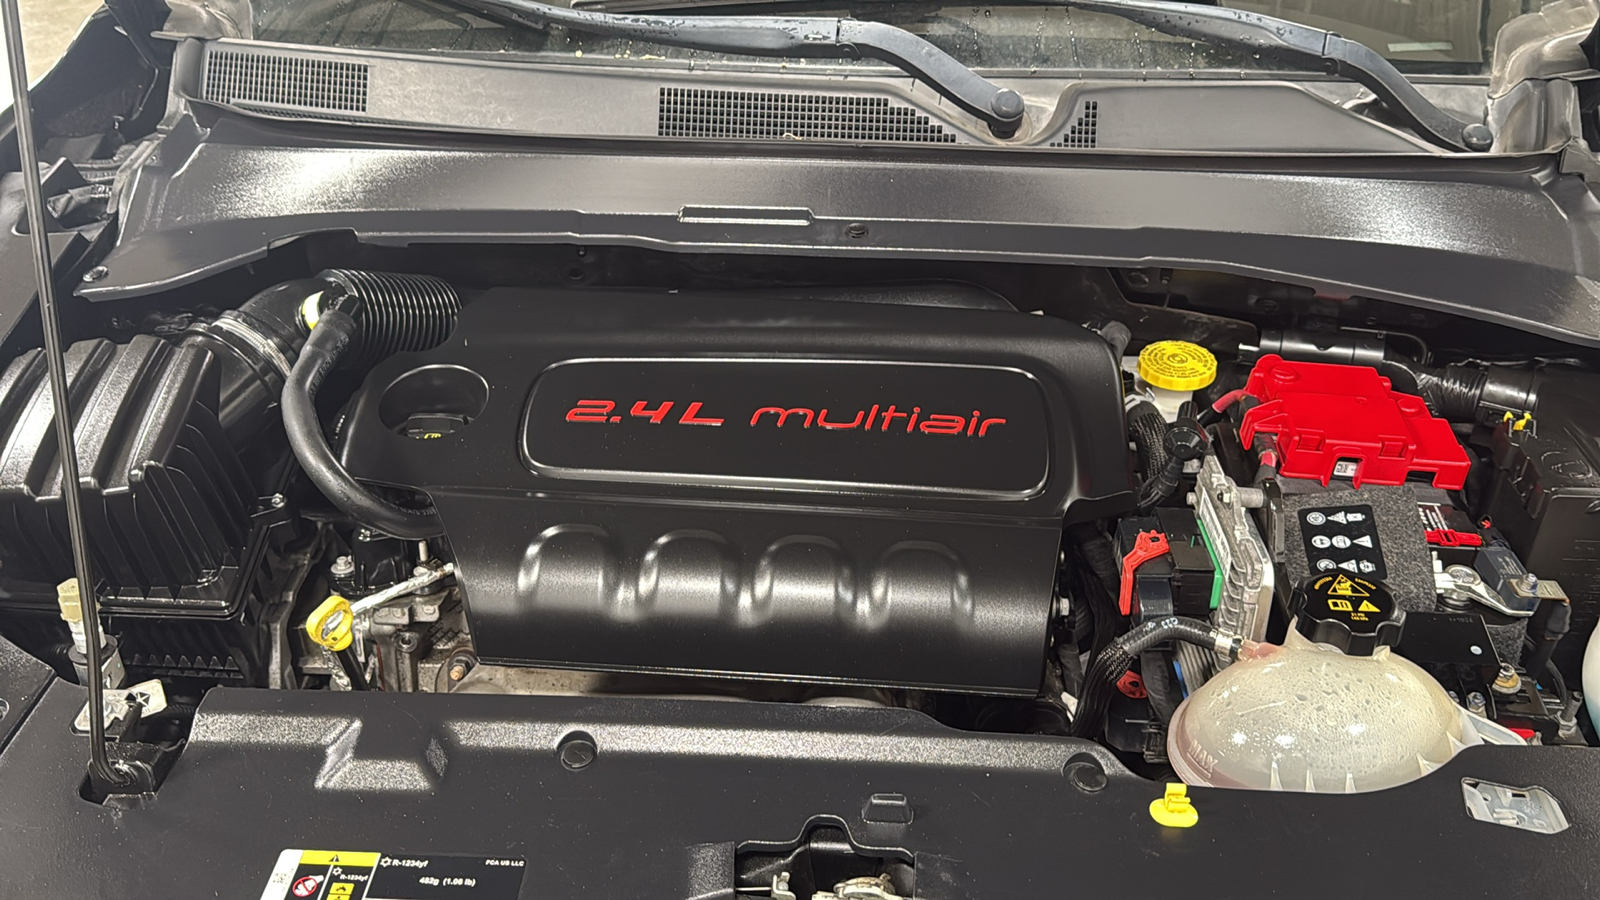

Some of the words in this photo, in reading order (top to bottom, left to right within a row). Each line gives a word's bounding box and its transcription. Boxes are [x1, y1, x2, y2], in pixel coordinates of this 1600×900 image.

[749, 404, 1007, 438] multiair
[1188, 739, 1218, 772] MAX
[392, 859, 429, 869] R-1234yf
[339, 874, 369, 882] R-1234yf
[464, 878, 476, 887] lb)
